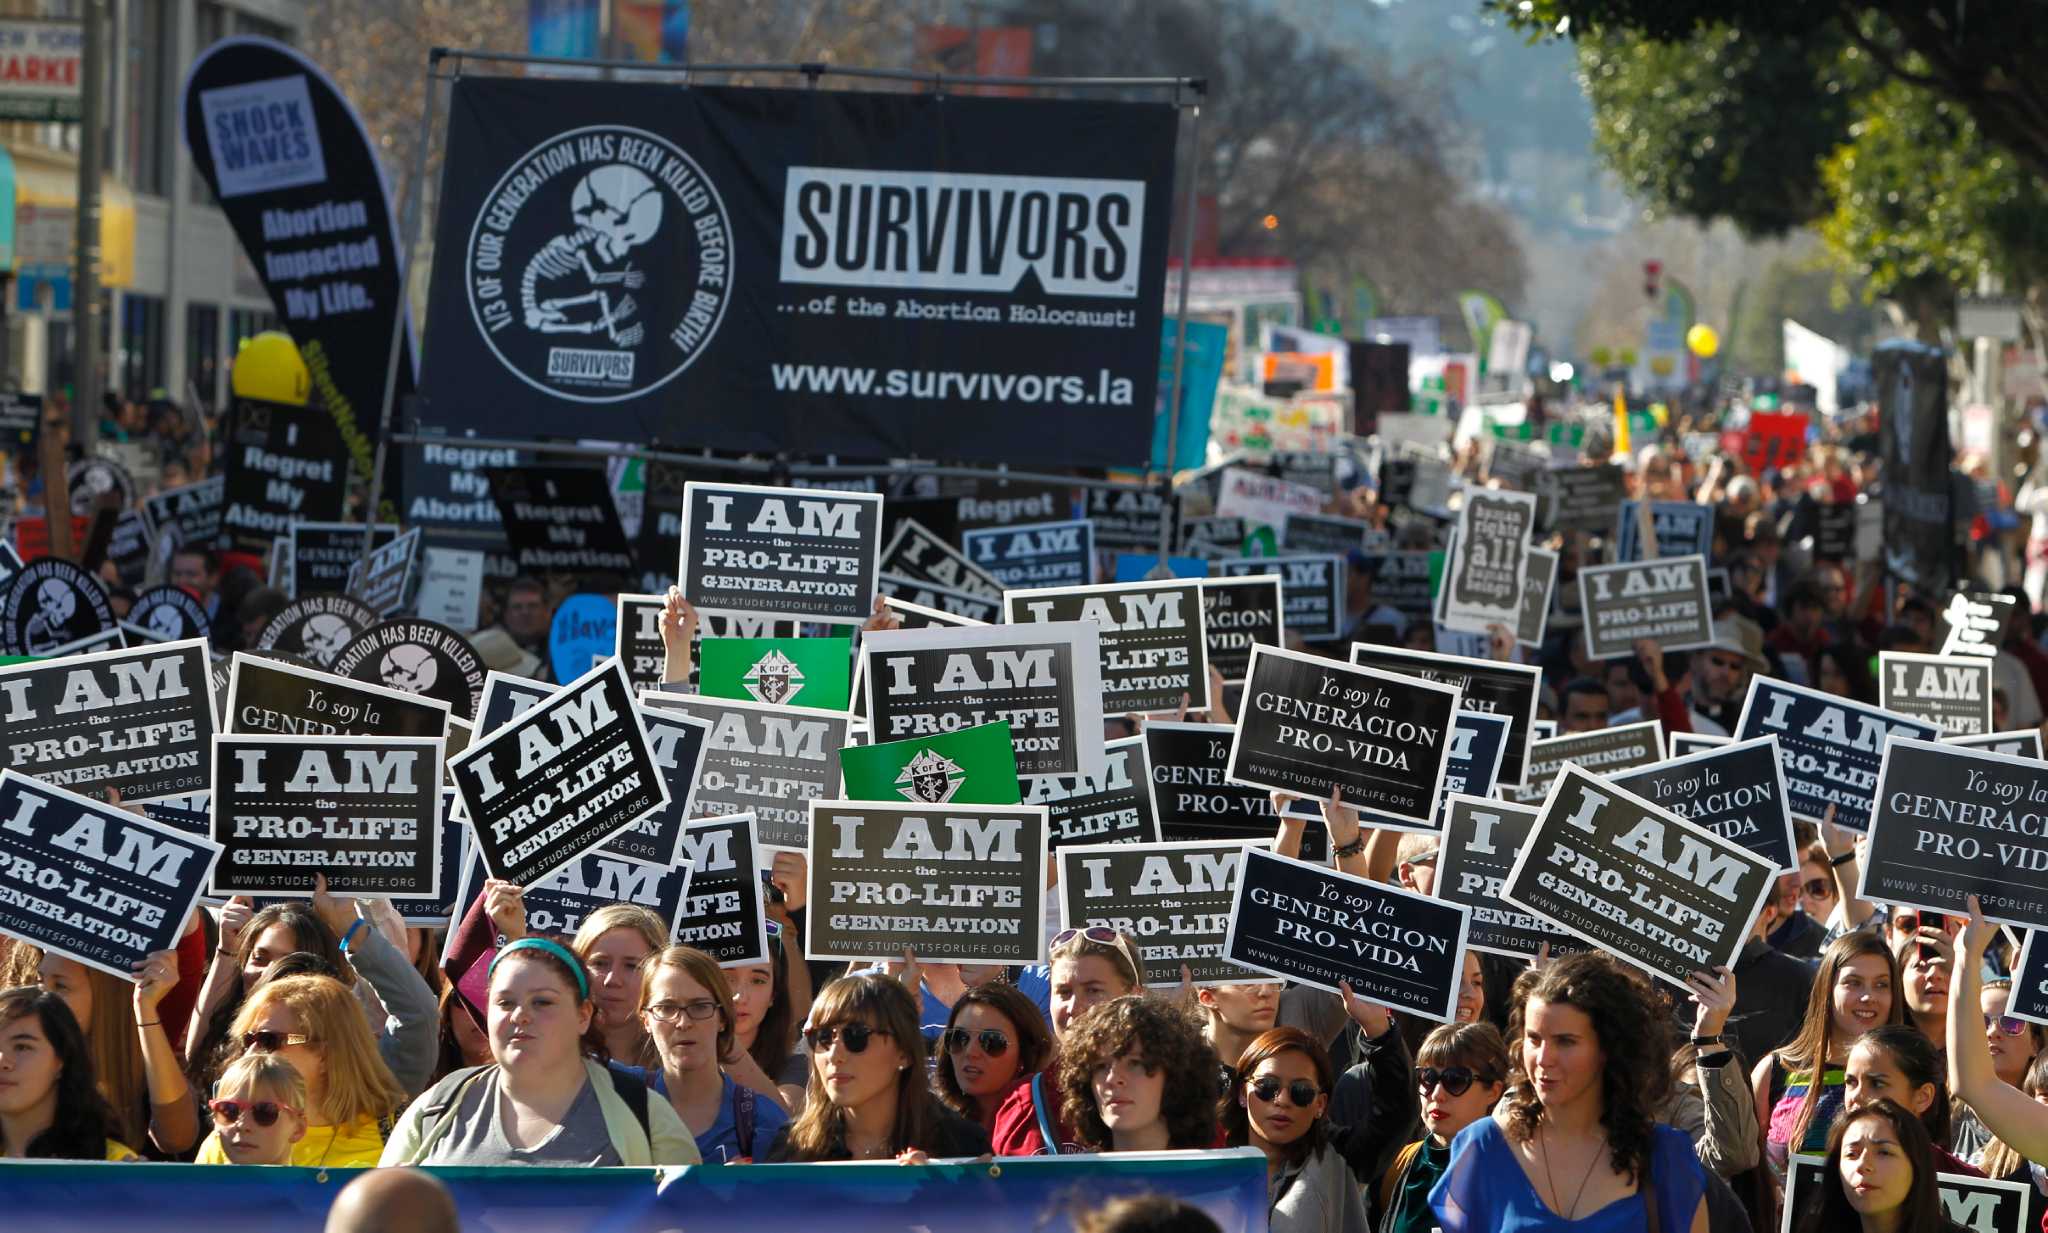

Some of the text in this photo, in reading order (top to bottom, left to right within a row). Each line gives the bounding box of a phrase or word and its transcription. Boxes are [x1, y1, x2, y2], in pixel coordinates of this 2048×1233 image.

[0, 55, 80, 87] ARKE
[215, 100, 304, 140] SHOCK
[218, 131, 311, 171] WAVES
[578, 135, 615, 162] HAS
[618, 136, 665, 172] BEEN
[488, 140, 577, 232] GENERATION
[659, 155, 711, 215] KILLED
[262, 200, 367, 241] Abortion
[793, 180, 1131, 282] SURVIVORS
[265, 239, 379, 282] Impacted
[477, 233, 505, 270] OUR
[693, 213, 725, 289] BEFORE
[285, 283, 374, 320] My Life.
[478, 277, 503, 299] OF
[670, 290, 718, 353] BIRTH!
[847, 298, 886, 317] the
[894, 300, 1000, 322] Abortion
[1008, 304, 1136, 328] Holocaust!
[551, 351, 632, 378] SURVIVORS
[771, 363, 1134, 405] www.survivors.la
[286, 422, 298, 446] I
[243, 447, 334, 483] Regret
[424, 444, 519, 468] Regret
[266, 480, 305, 507] My
[451, 472, 489, 497] My
[224, 502, 293, 531] Abor
[511, 502, 605, 524] Regret
[705, 495, 733, 531] I
[747, 498, 862, 539] AM
[957, 493, 1055, 523] Regret
[547, 527, 585, 545] My
[773, 538, 792, 548] the
[977, 528, 1081, 561] I AM
[1471, 537, 1517, 571] all
[520, 549, 631, 568] Abortion
[702, 548, 859, 576] PRO-LIFE
[902, 535, 1000, 601] I AM
[701, 575, 858, 597] GENERATION
[1593, 564, 1695, 600] I AM
[301, 597, 354, 615] HAS BEEN
[700, 594, 857, 614] WWW.STUDENTSFORLIFE.ORG
[1079, 591, 1186, 632] AM
[1205, 609, 1273, 629] ACION
[1597, 601, 1699, 627] PRO-LIFE
[1100, 637, 1118, 646] the
[1600, 621, 1699, 642] GENERATION
[334, 624, 483, 688] ERATION HAS BEEN KILLED BY
[886, 649, 1056, 695] I AM
[1100, 647, 1189, 670] -LIFE
[1, 655, 190, 723] I AM
[1101, 674, 1190, 692] RATION
[1319, 676, 1391, 709] Yo soy la
[1892, 664, 1981, 700] I AM
[306, 690, 381, 726] Yo soy la
[963, 696, 983, 705] the
[88, 715, 111, 725] the
[707, 712, 829, 761] AM
[1255, 692, 1439, 748] GENERACION
[1762, 692, 1920, 755] I AM
[9, 719, 196, 766] PRO-LIFE
[467, 752, 505, 803] I
[515, 680, 618, 778] AM
[1208, 740, 1226, 759] Yo
[1276, 725, 1411, 771] PRO-VIDA
[1824, 745, 1843, 757] the
[33, 750, 199, 786] ENERATION
[234, 750, 418, 794] I AM
[545, 762, 564, 779] the
[730, 757, 750, 767] the
[490, 739, 635, 845] PRO-LIFE
[1653, 767, 1719, 798] Yo soy la
[1965, 769, 2048, 805] Yo soy la
[315, 800, 337, 809] the
[502, 771, 642, 869] GENERATION
[1051, 804, 1069, 815] the
[1890, 792, 2048, 837] GENERACI
[2, 790, 194, 888] I AM
[233, 816, 417, 841] PRO-LIFE
[832, 816, 1022, 861] I AM
[1049, 807, 1139, 839] -LIFE
[1465, 811, 1500, 854] I
[232, 849, 416, 867] GENERATION
[1566, 785, 1751, 902] I AM
[1914, 830, 2048, 872] PRO-VID
[73, 860, 95, 875] the
[915, 867, 938, 876] the
[1082, 853, 1241, 897] I AM
[1634, 863, 1656, 881] the
[0, 852, 167, 929] PRO-LIFE
[561, 897, 581, 908] the
[830, 881, 1022, 908] PRO-LIFE
[1160, 899, 1182, 908] the
[1319, 881, 1395, 917] Yo soy la
[1546, 842, 1725, 942] PRO-LIFE
[0, 885, 152, 951] ENERATION
[829, 915, 1021, 934] GENERATION
[1250, 887, 1449, 955] GENERACION
[1528, 891, 1692, 978] WWW.STUDENTSFORLIFE.OR
[1537, 871, 1711, 964] GENERATION
[828, 940, 1020, 954] WWW.STUDENTSFORLIFE.ORG
[1275, 918, 1422, 974] PRO-VIDA
